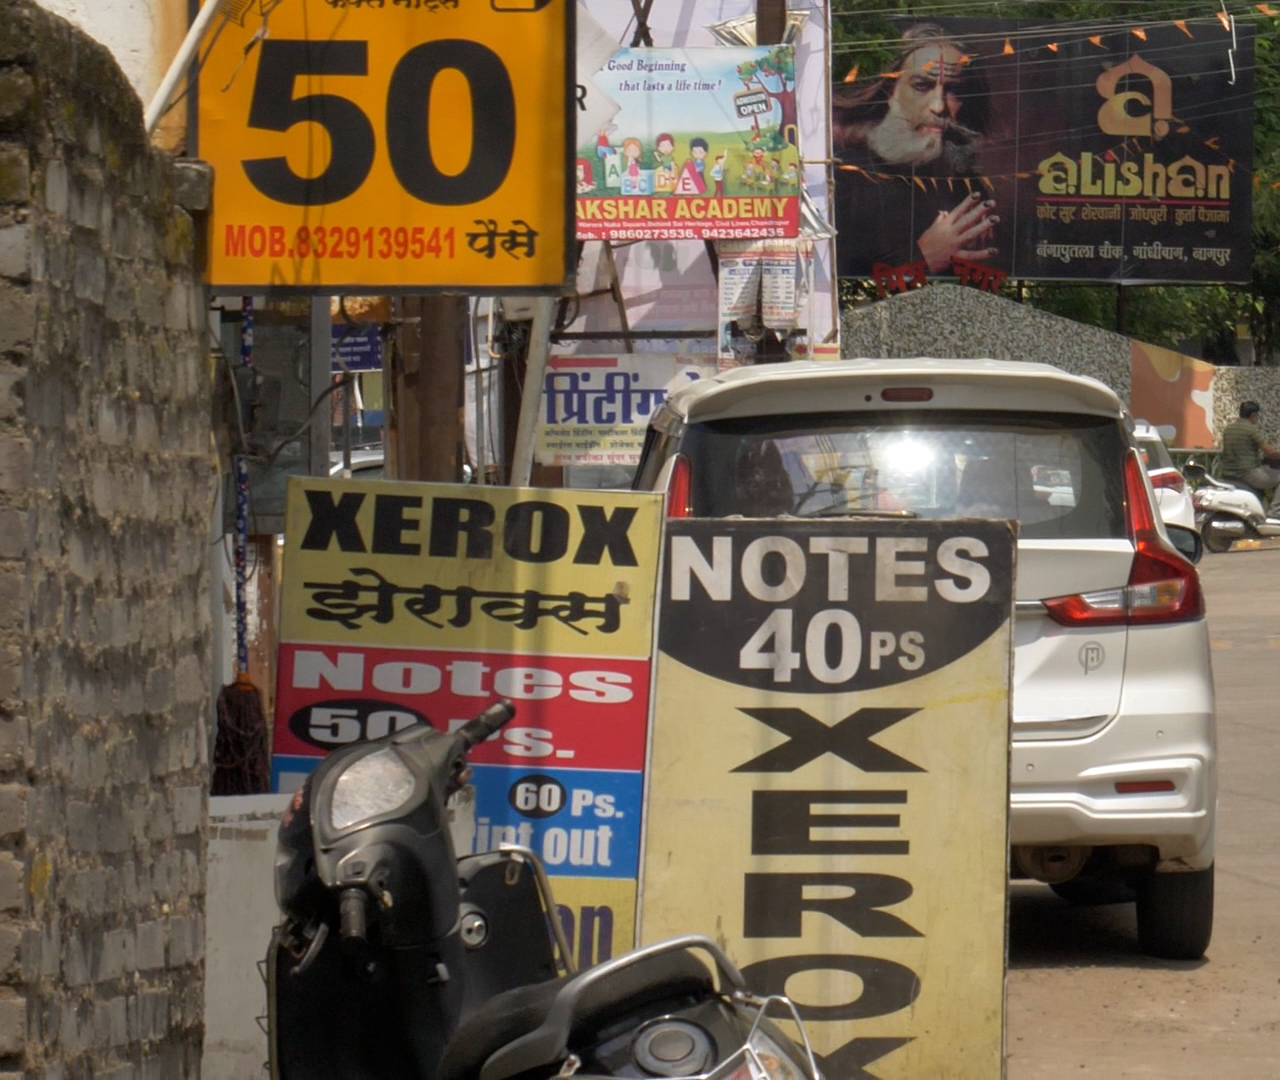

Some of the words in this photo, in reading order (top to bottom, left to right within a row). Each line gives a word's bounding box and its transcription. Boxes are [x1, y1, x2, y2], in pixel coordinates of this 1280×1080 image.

[607, 60, 633, 71] Good
[637, 60, 687, 73] Beginning
[619, 80, 640, 91] that
[240, 38, 517, 206] 50
[740, 103, 767, 115] OPEN
[675, 198, 788, 218] ACADEMY
[224, 225, 456, 259] MOB.8329139541
[466, 219, 539, 260] पैसे
[300, 490, 639, 567] XEROX
[670, 535, 991, 603] NOTES
[303, 567, 631, 636] झेराक्स
[739, 608, 862, 684] 40
[870, 631, 926, 671] PS
[292, 650, 634, 704] Notes
[516, 783, 561, 812] 60
[571, 789, 624, 818] Ps.
[543, 825, 613, 866] out
